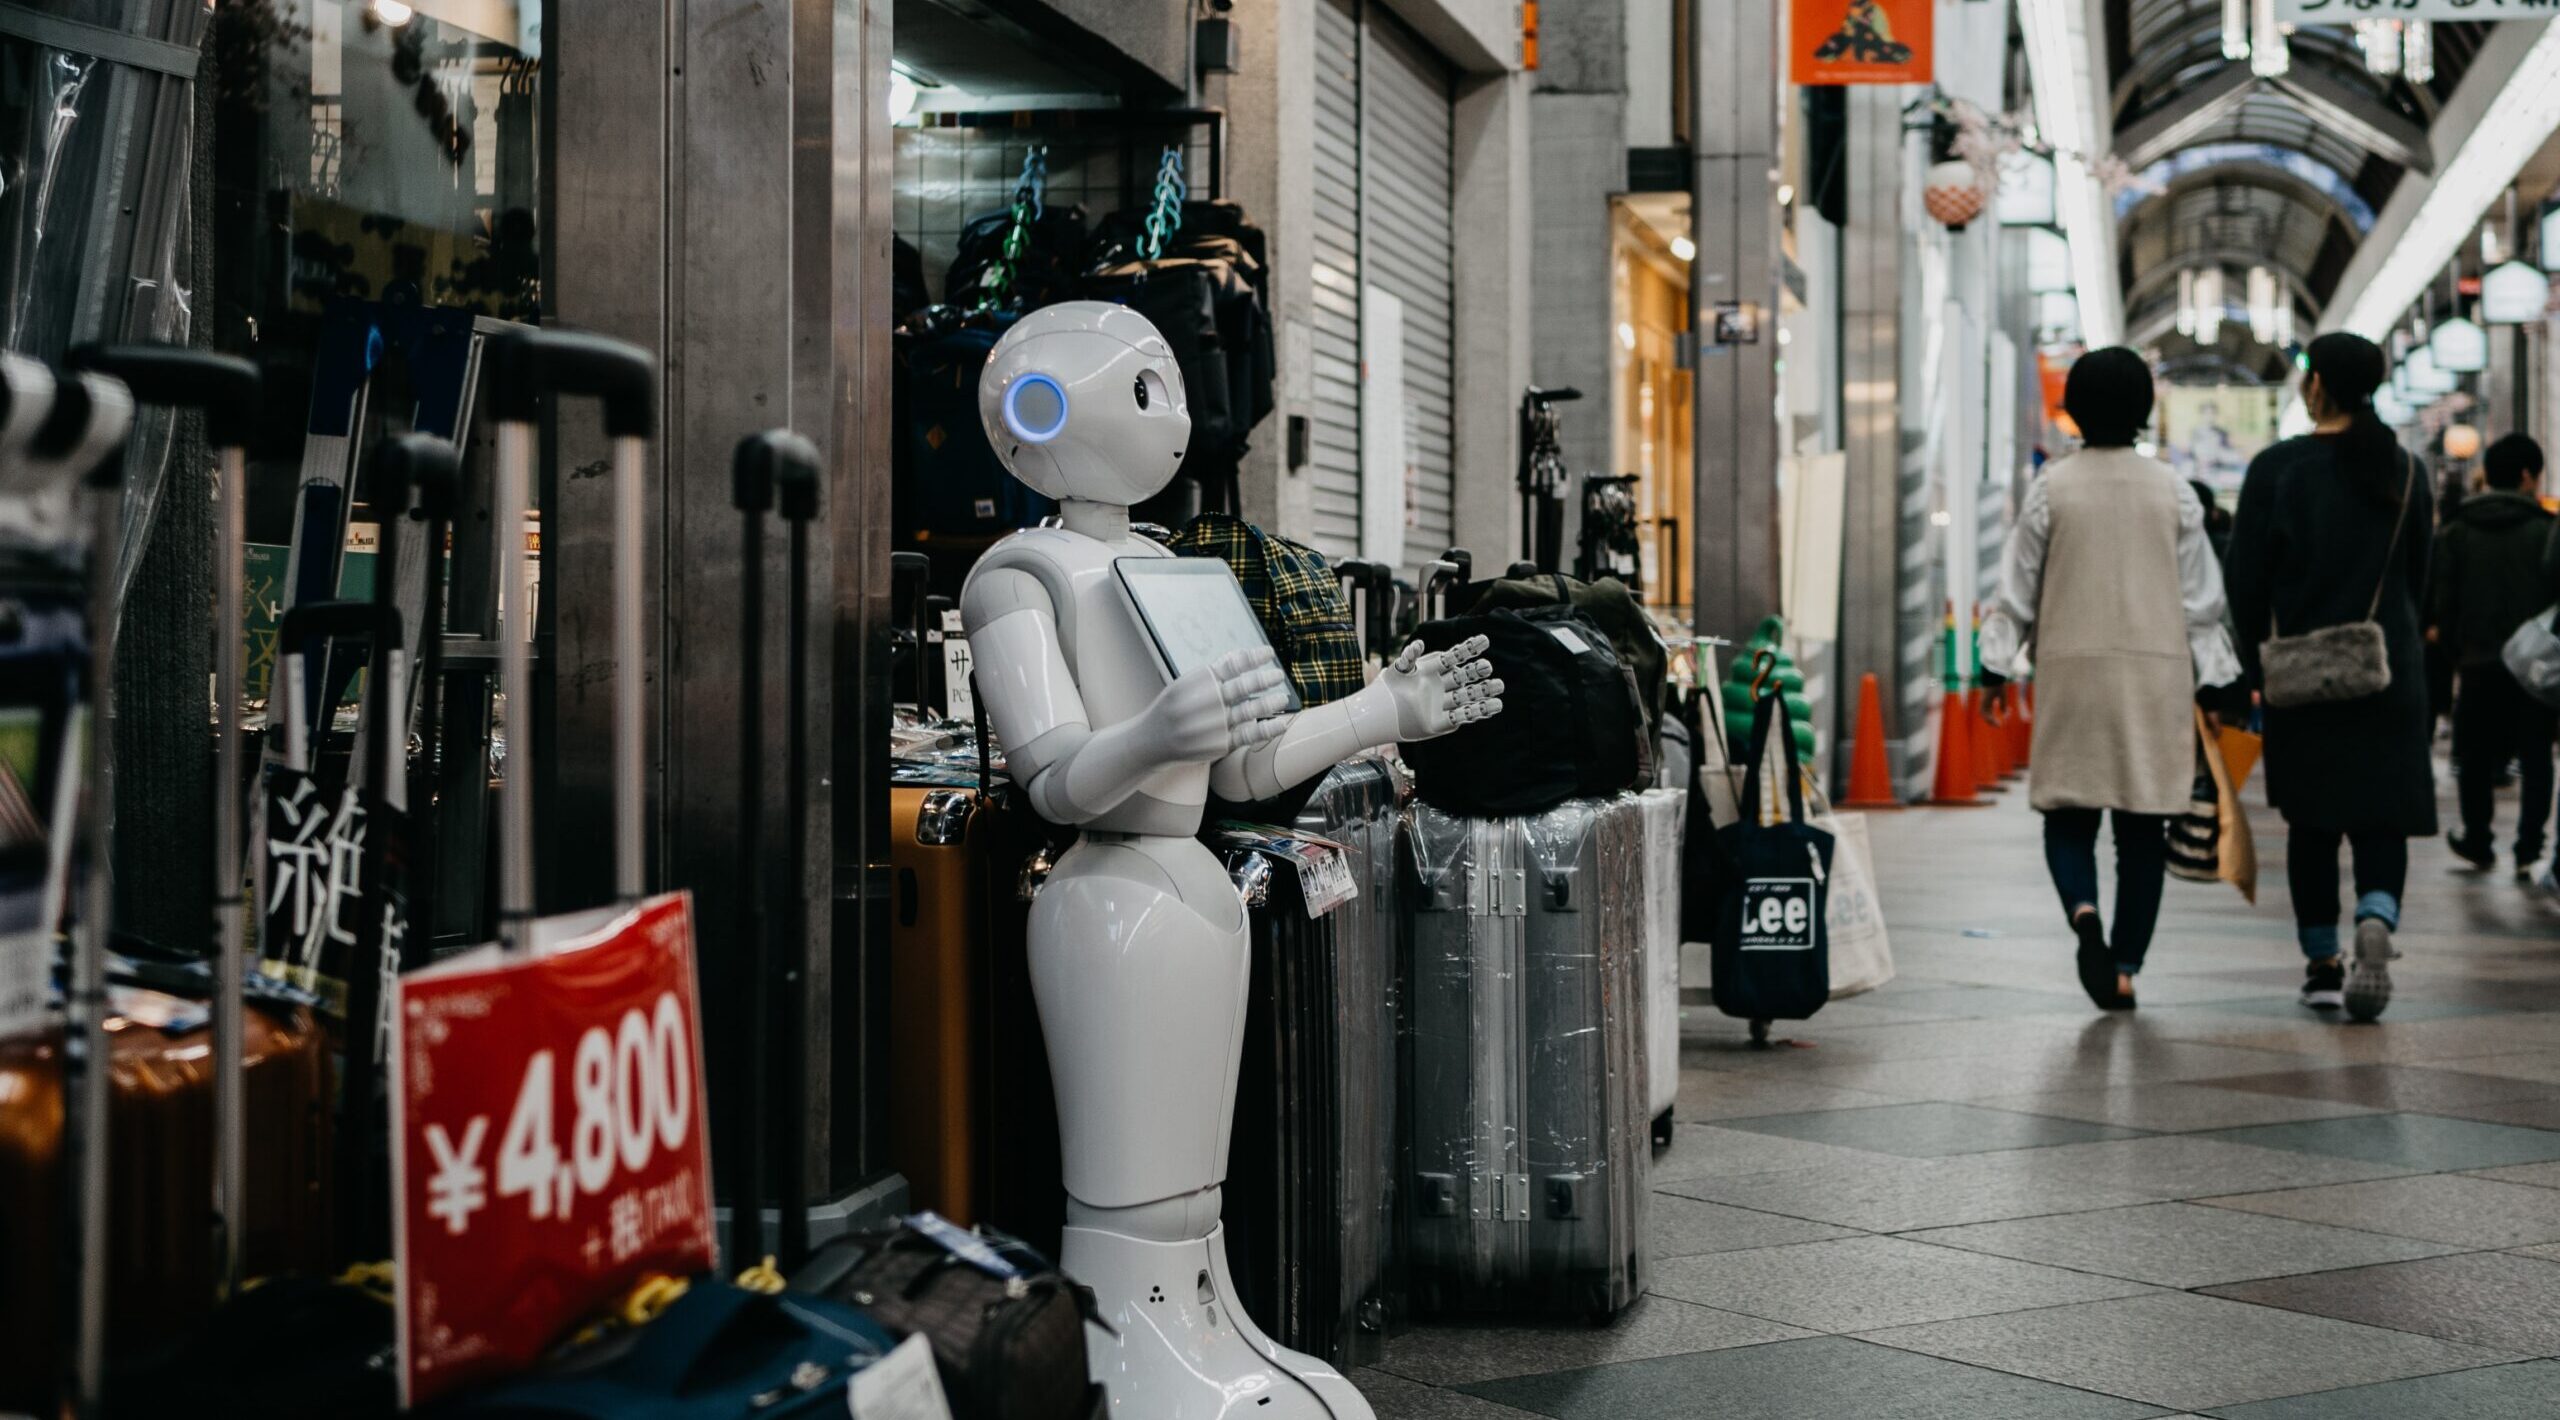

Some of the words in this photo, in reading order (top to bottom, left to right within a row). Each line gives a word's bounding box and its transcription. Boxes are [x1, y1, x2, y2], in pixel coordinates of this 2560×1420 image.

[950, 648, 970, 680] サ
[1741, 896, 1807, 934] Lee
[1829, 888, 1868, 928] ee
[424, 992, 692, 1236] ¥4,800
